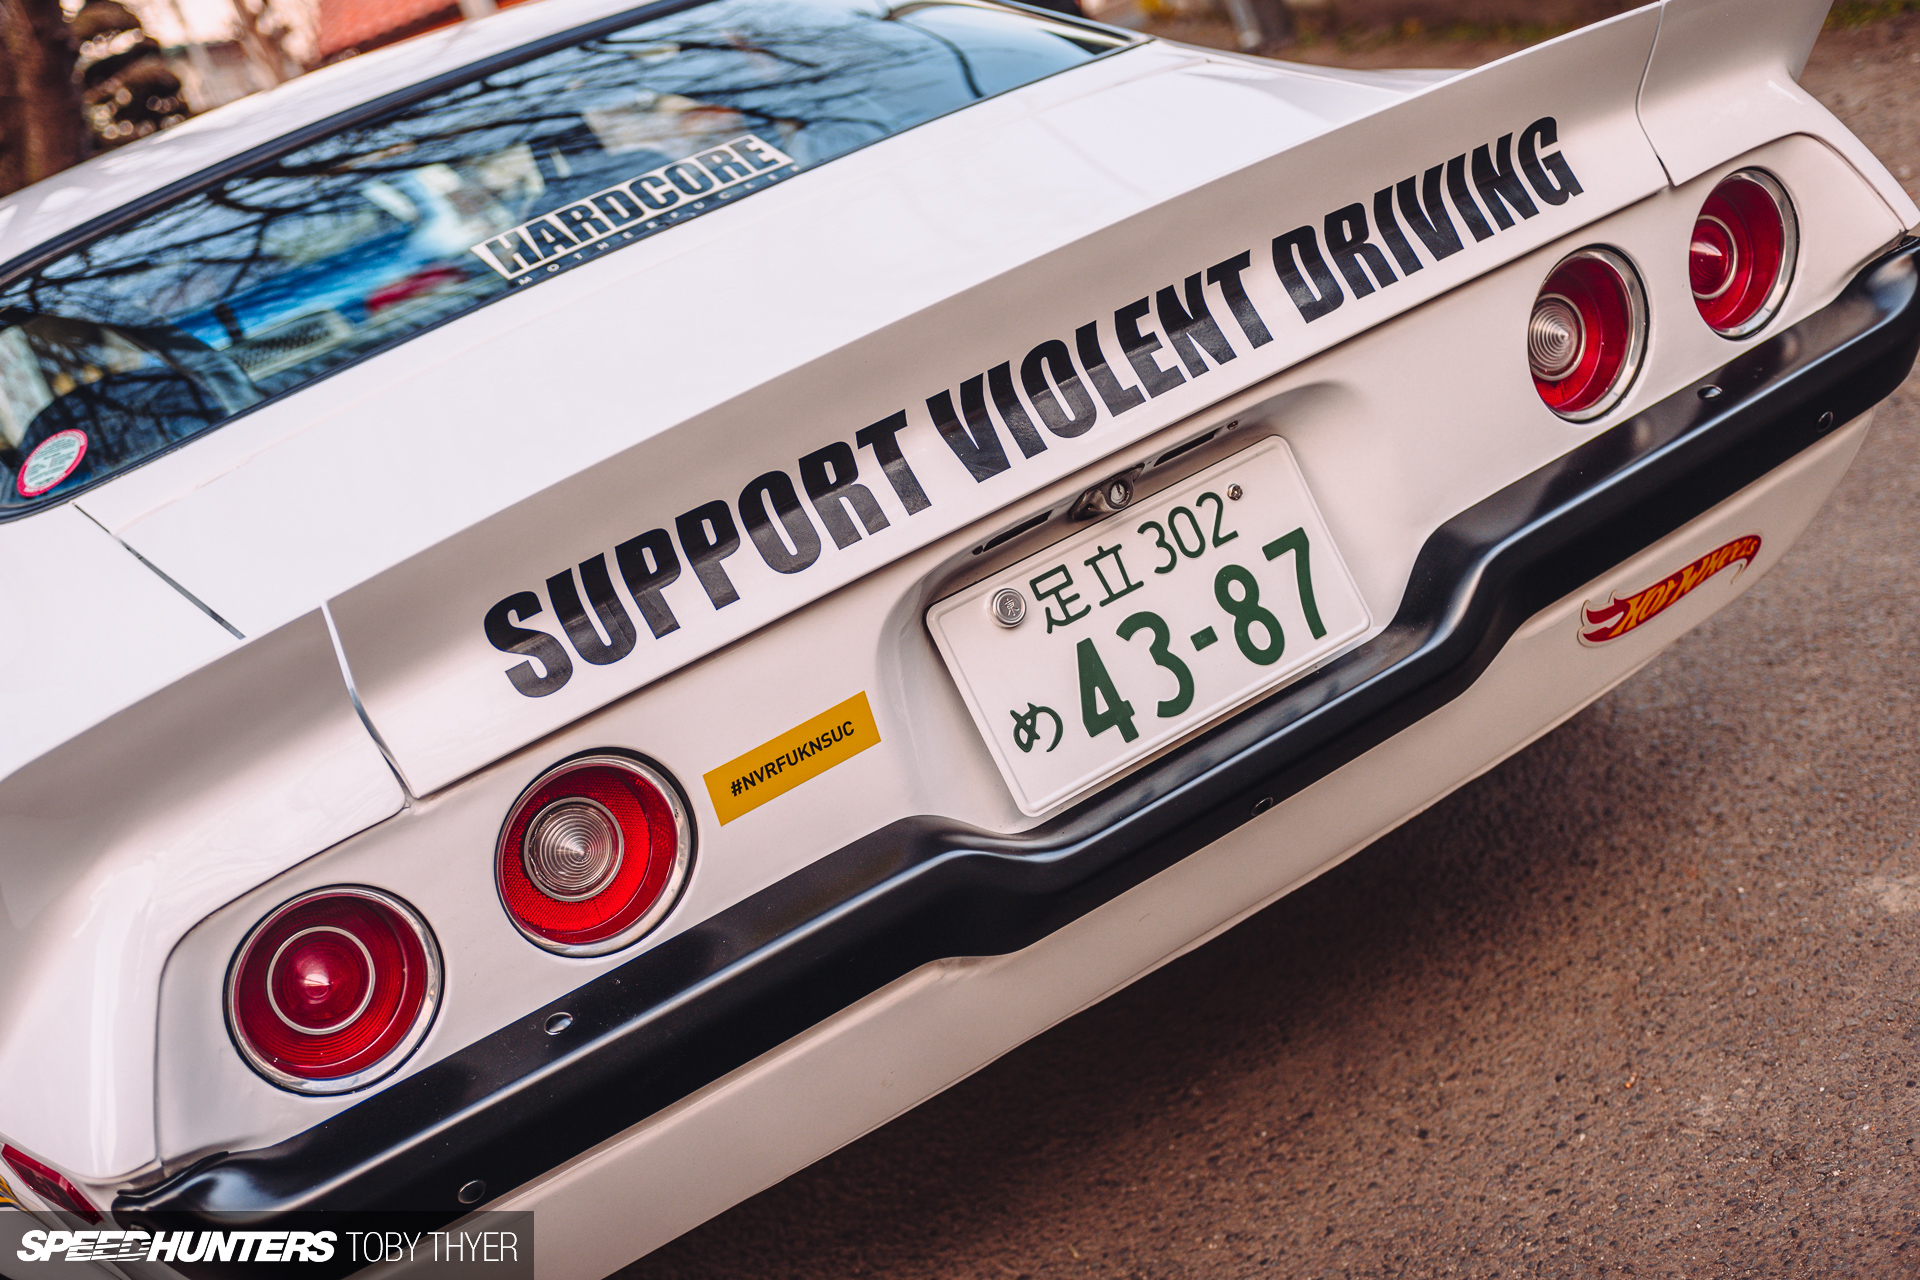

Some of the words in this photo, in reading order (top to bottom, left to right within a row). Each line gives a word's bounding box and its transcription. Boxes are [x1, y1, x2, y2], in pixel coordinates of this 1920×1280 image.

[484, 137, 781, 274] HARDCORE
[517, 163, 801, 286] MOTHERFUCKER
[483, 408, 932, 698] SUPPORT
[925, 248, 1275, 484] VIOLENT
[1271, 115, 1585, 324] DRIVING
[1028, 543, 1145, 635] 足立
[1136, 491, 1240, 575] 302
[1009, 702, 1064, 753] め
[1075, 526, 1328, 744] 43-87
[730, 720, 855, 798] #NVRFUKNSUC
